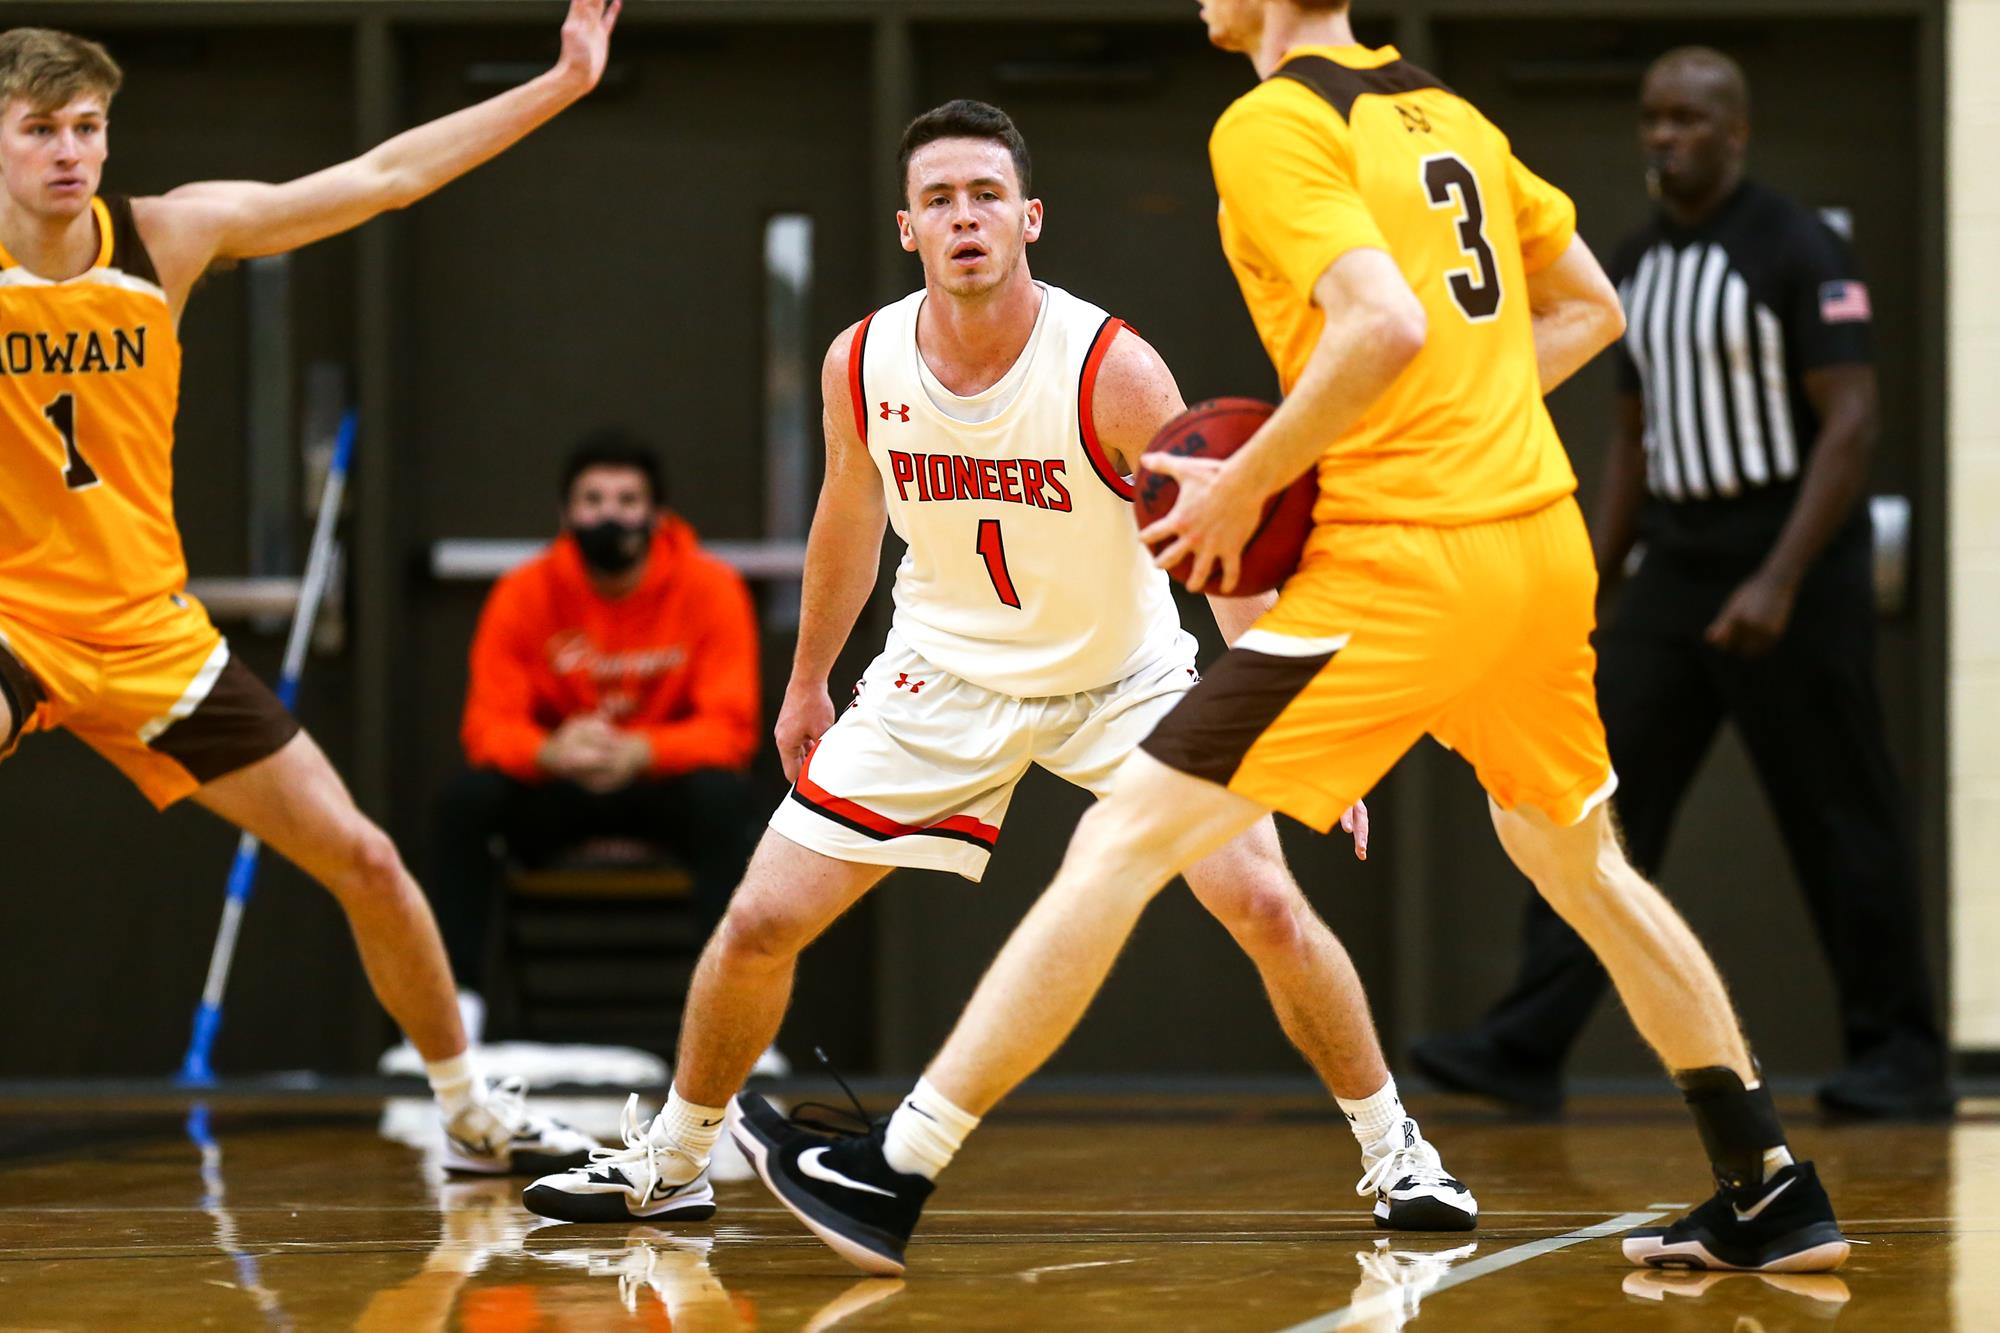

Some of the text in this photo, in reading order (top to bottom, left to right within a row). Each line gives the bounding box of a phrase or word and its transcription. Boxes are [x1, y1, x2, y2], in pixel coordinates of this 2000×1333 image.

[1420, 153, 1503, 321] 3
[0, 326, 146, 375] OWAN
[43, 392, 102, 491] 1
[888, 449, 1073, 513] PIONEERS
[976, 518, 1022, 610] 1
